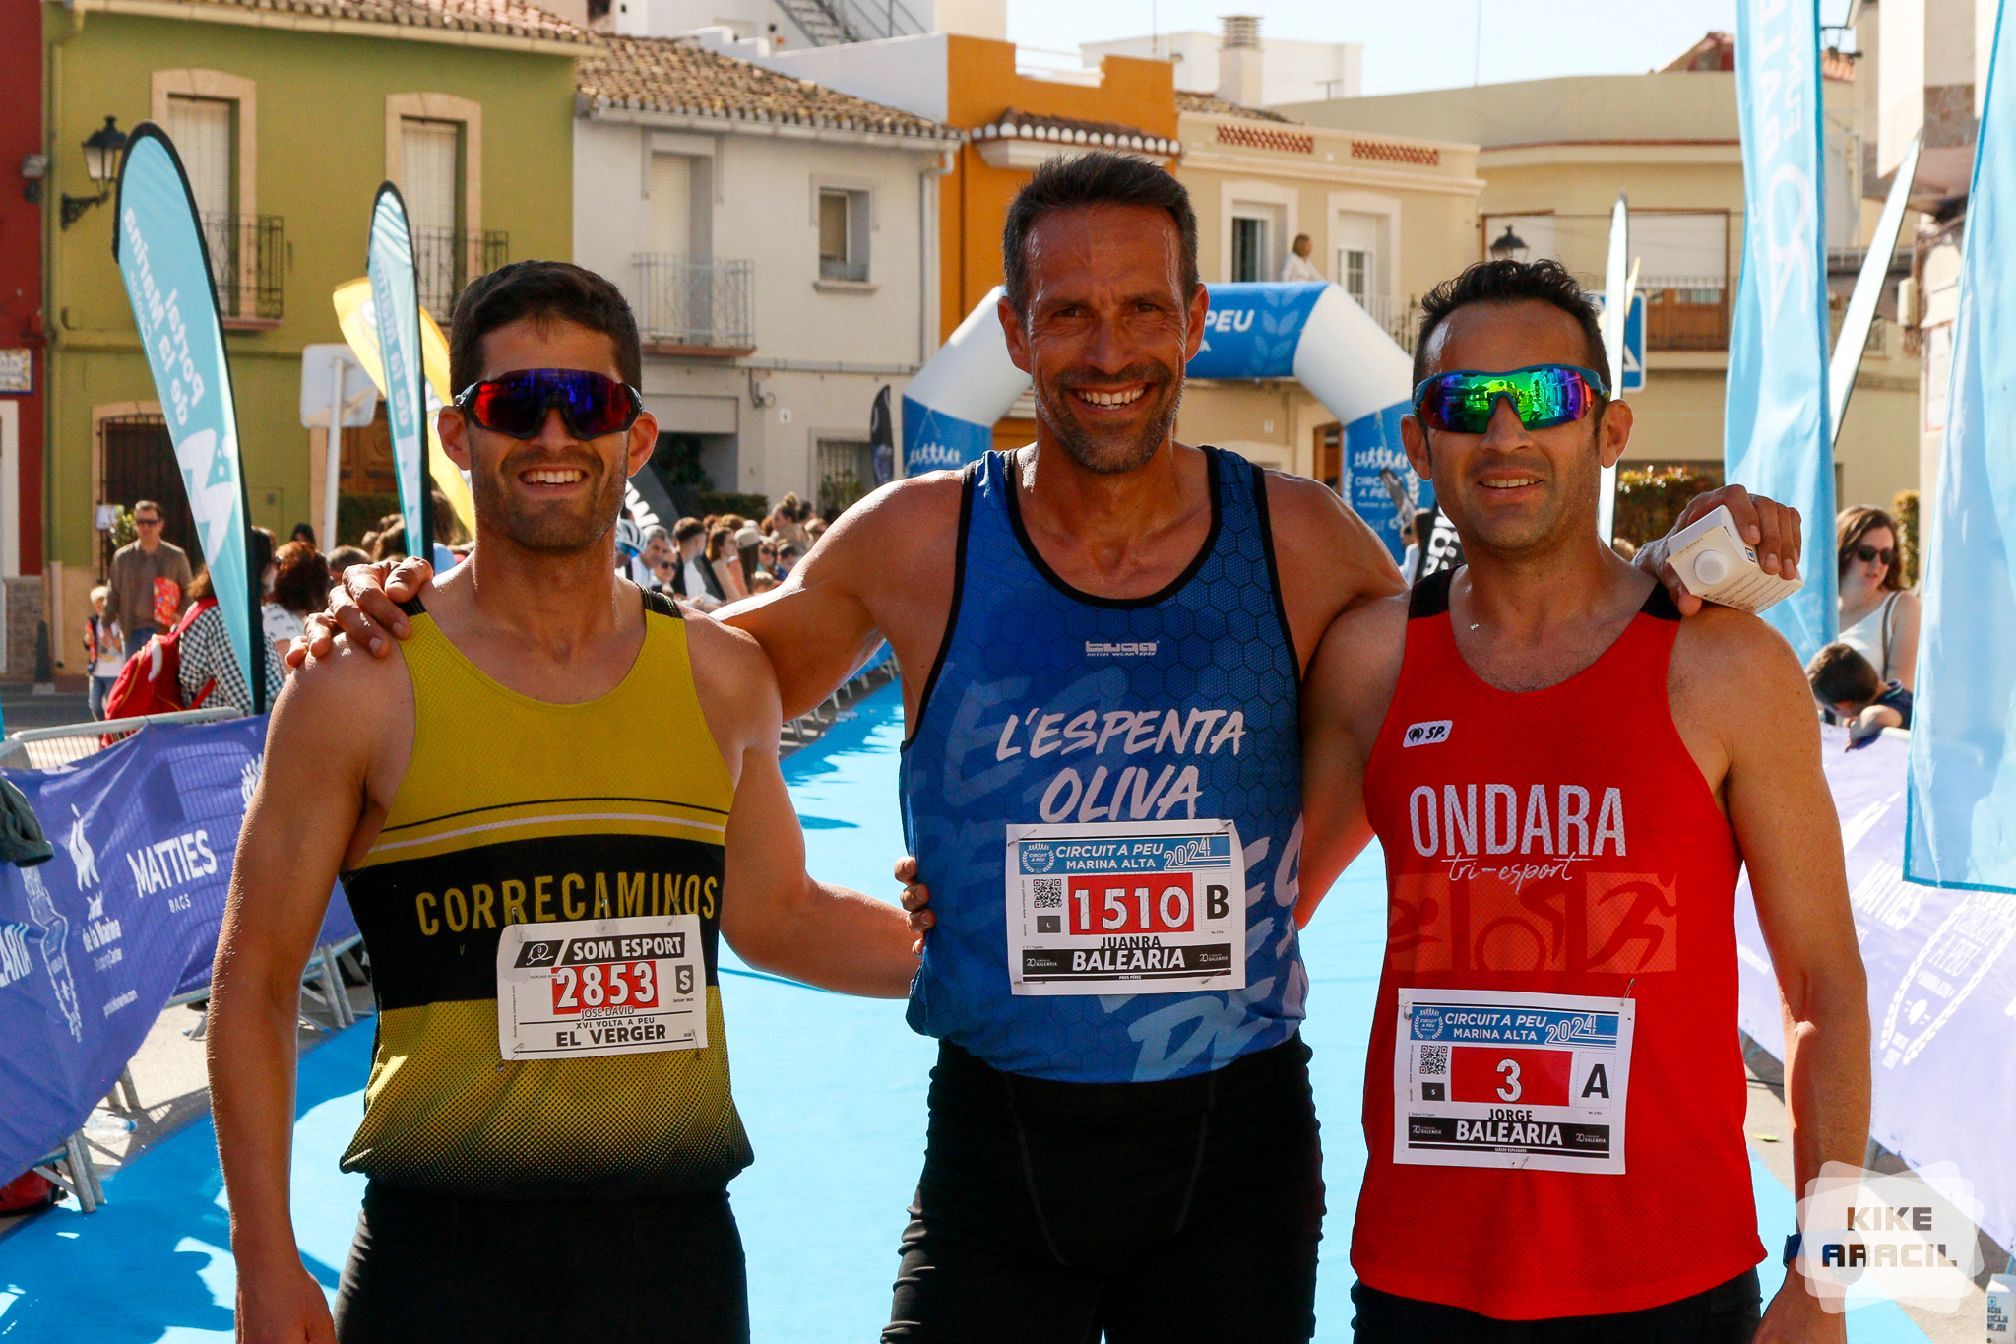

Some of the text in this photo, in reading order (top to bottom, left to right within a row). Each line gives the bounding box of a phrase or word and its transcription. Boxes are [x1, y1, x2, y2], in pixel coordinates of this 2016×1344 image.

[1205, 309, 1255, 332] PEU
[996, 707, 1246, 762] L'ESPENTA
[1039, 763, 1204, 822] OLIVA
[1408, 784, 1626, 858] ONDARA
[126, 829, 218, 898] MATTIES
[1056, 843, 1164, 859] CIRCUIT A PEU
[1066, 858, 1156, 870] MARINA ALTA
[1163, 837, 1211, 871] 2024
[1440, 852, 1593, 895] tri-esport
[167, 893, 192, 914] BAGS
[414, 871, 719, 936] CORRECAMINOS
[1074, 886, 1190, 930] 1510
[1206, 884, 1230, 920] B
[573, 936, 682, 960] SOM ESPORT
[1100, 935, 1162, 949] JUANRA
[556, 962, 656, 1008] 2853
[679, 970, 691, 990] S
[576, 1022, 593, 1030] XVI
[596, 1019, 623, 1028] VOLTA
[638, 1017, 656, 1025] PEU
[581, 1006, 635, 1020] JOSE DAVID
[1445, 1012, 1548, 1027] CIRCUIT A PEU
[556, 1024, 666, 1047] EL VERGER
[1453, 1028, 1538, 1041] MARINA ALTA
[1544, 1014, 1597, 1045] 2024
[1496, 1058, 1522, 1102] 3
[1581, 1063, 1610, 1099] A
[1488, 1108, 1533, 1122] JORGE
